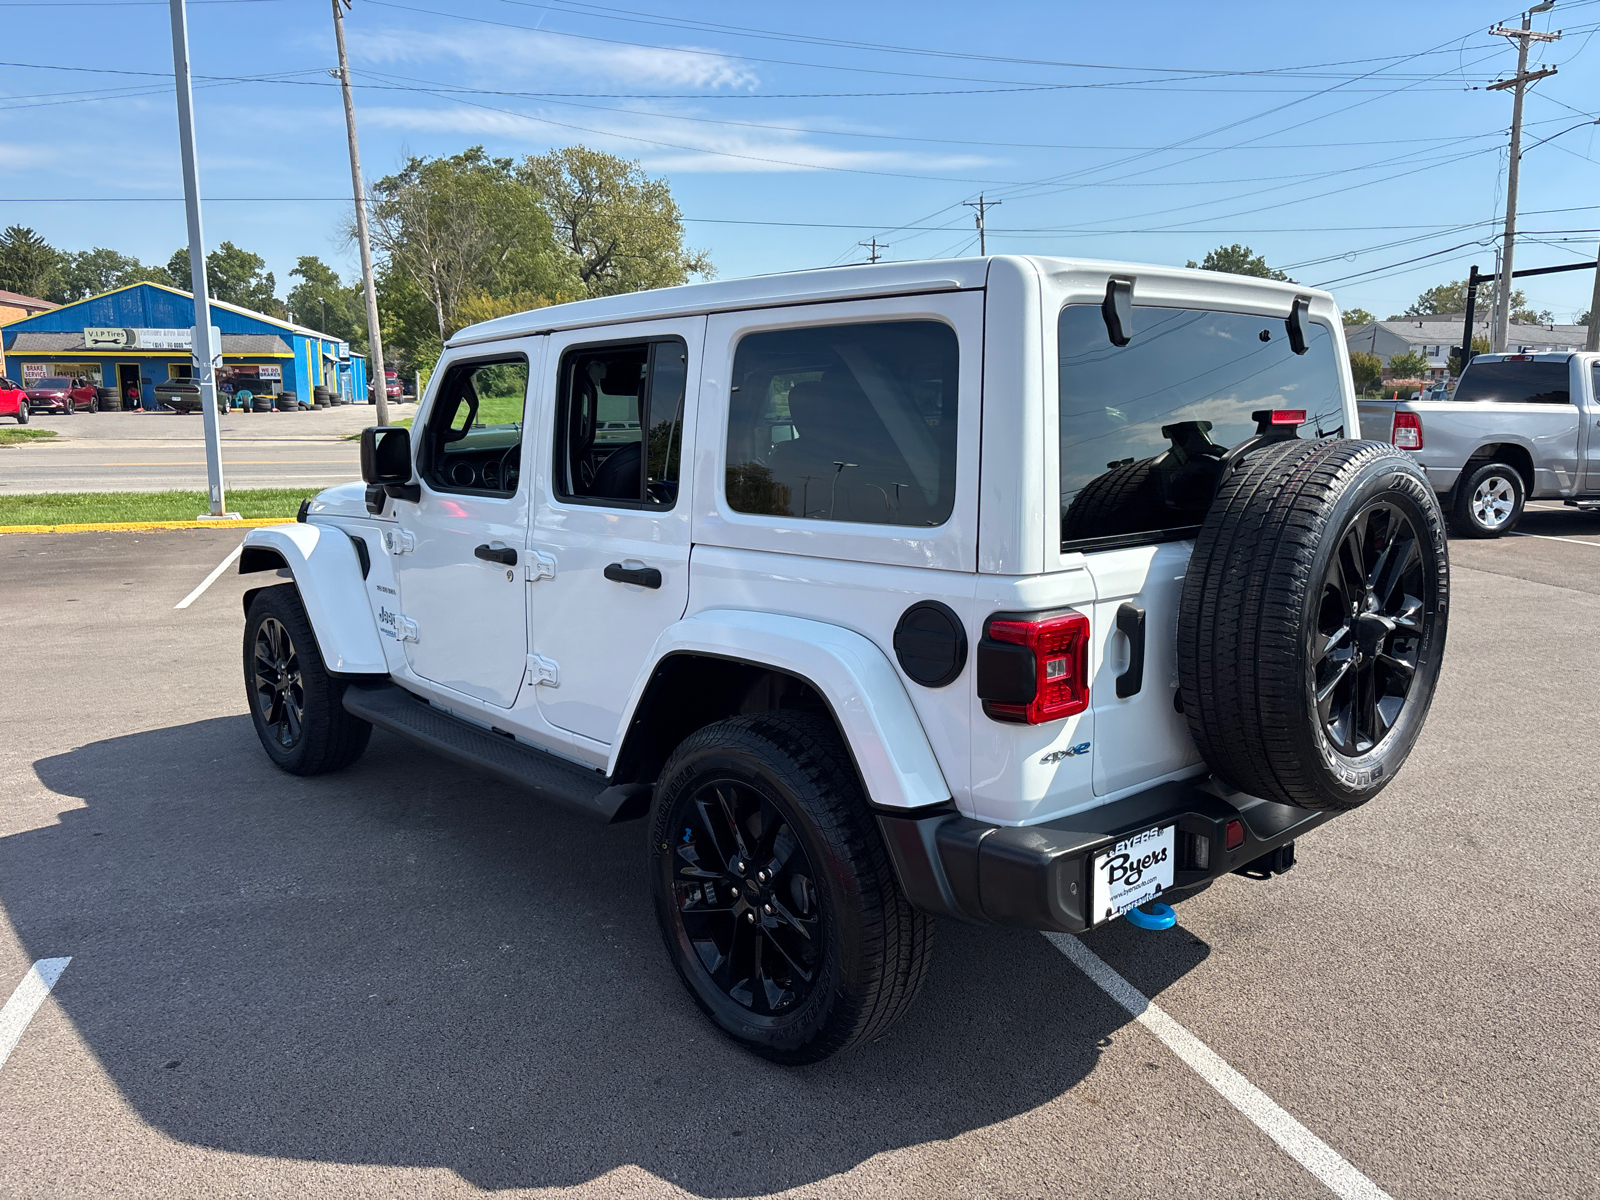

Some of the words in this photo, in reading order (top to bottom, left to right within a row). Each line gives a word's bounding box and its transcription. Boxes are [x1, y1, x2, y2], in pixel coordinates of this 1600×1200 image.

[1387, 474, 1448, 614] BRIDGESTONE
[1039, 741, 1091, 765] 4xe
[652, 764, 698, 859] YOKOHAMA
[1115, 827, 1160, 855] BYERS
[1100, 846, 1168, 887] Byers
[1109, 875, 1158, 902] www.byersauto.com
